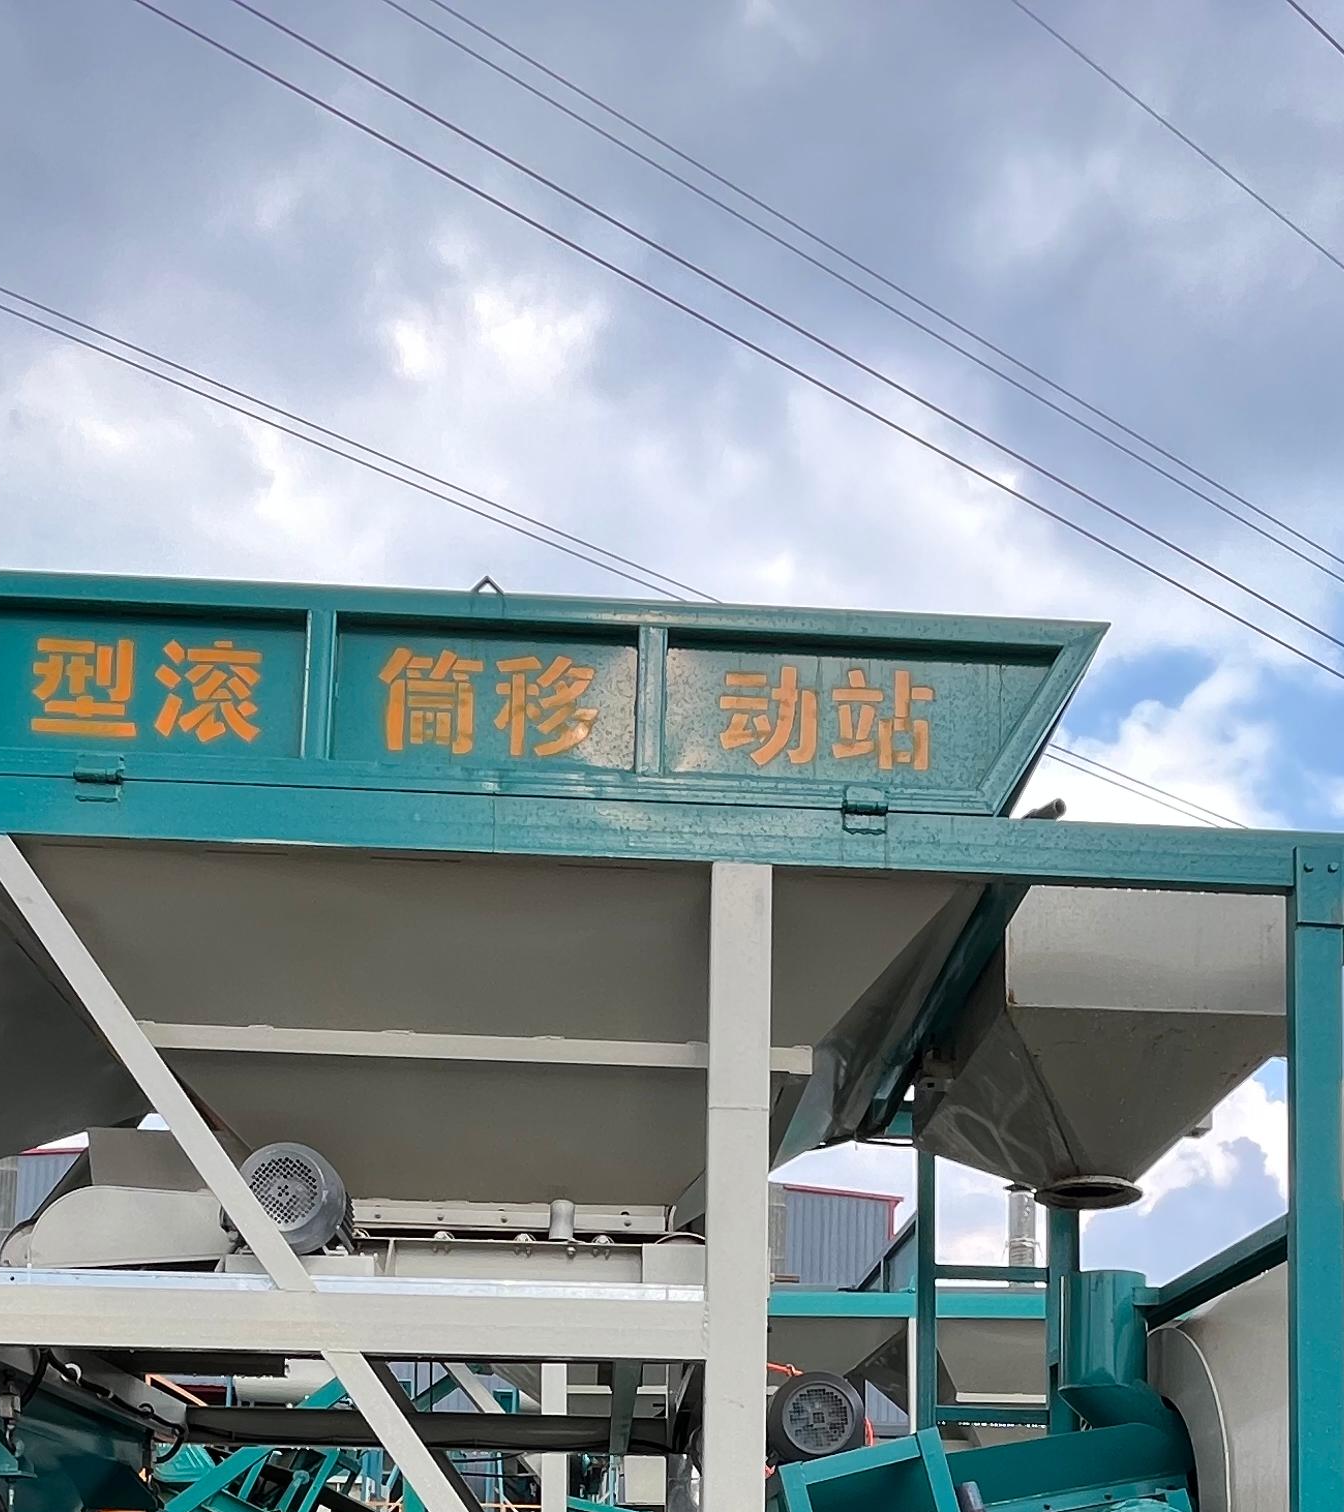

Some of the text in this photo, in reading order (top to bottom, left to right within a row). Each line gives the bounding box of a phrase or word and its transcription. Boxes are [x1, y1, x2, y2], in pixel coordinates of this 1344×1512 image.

[31, 638, 262, 742] 型滚
[378, 647, 599, 756] 筒移
[718, 666, 934, 770] 动站
